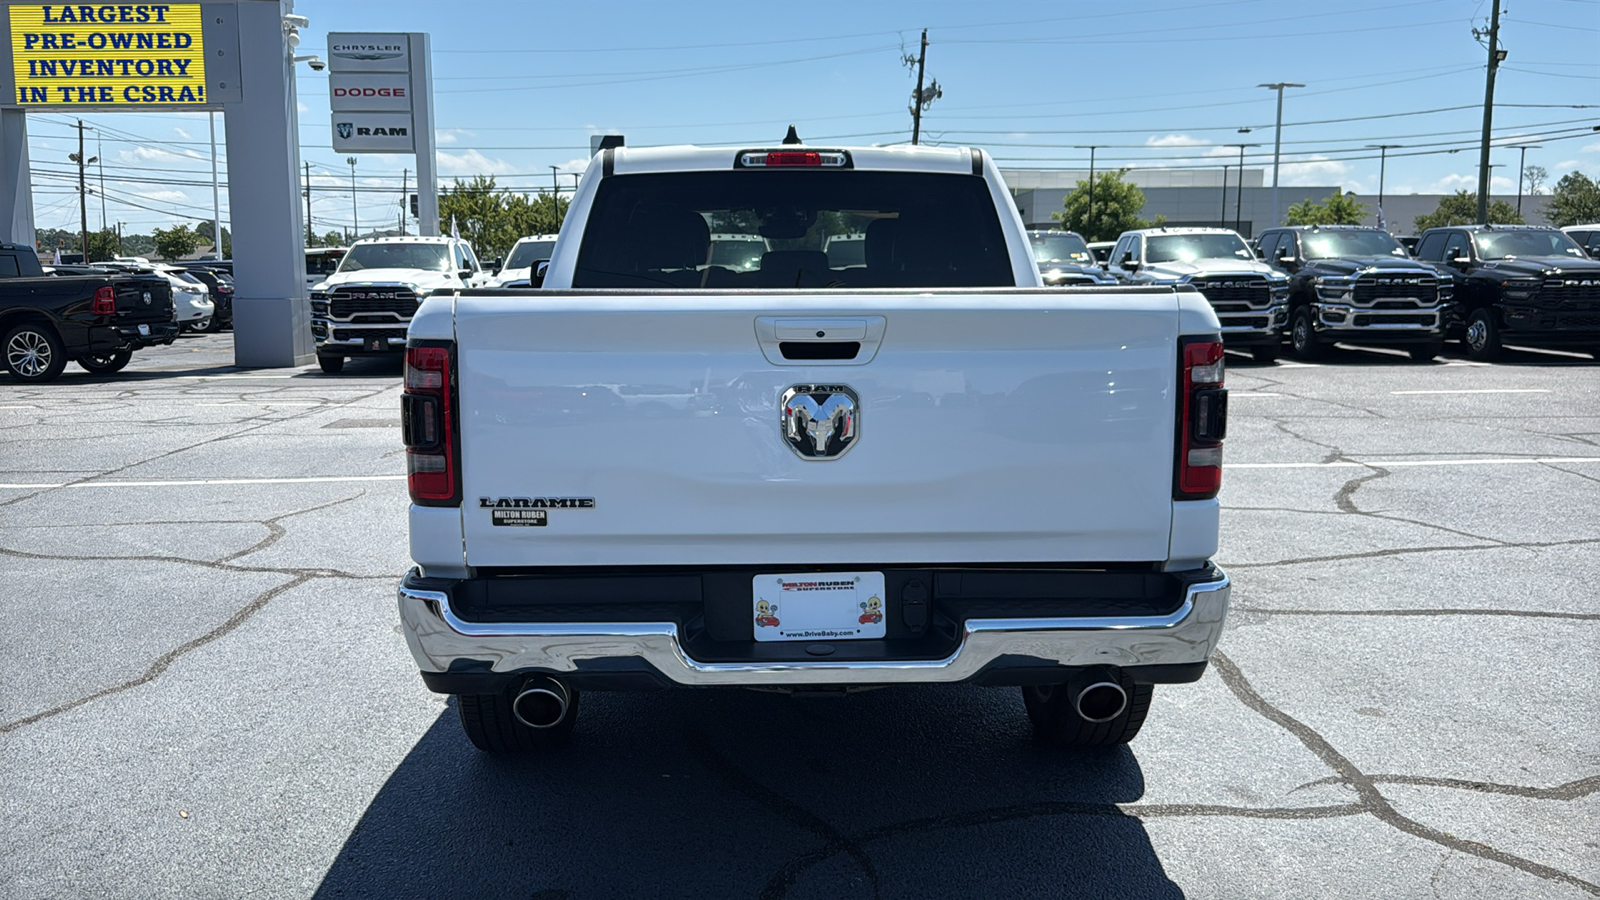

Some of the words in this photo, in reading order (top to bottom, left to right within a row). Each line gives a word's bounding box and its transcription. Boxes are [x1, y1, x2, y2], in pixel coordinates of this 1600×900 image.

[42, 6, 169, 22] LARGEST
[23, 32, 193, 50] PRE-OWNED
[28, 59, 192, 76] INVENTORY
[18, 86, 48, 103] IN
[58, 86, 114, 103] THE
[123, 85, 205, 103] CSRA!
[333, 87, 406, 98] DODGE
[356, 127, 408, 137] RAM
[1377, 278, 1418, 286] RAM
[797, 385, 844, 393] RAM
[479, 497, 596, 509] LARAMIE
[494, 510, 520, 519] MILTON
[521, 510, 545, 519] RUBEN
